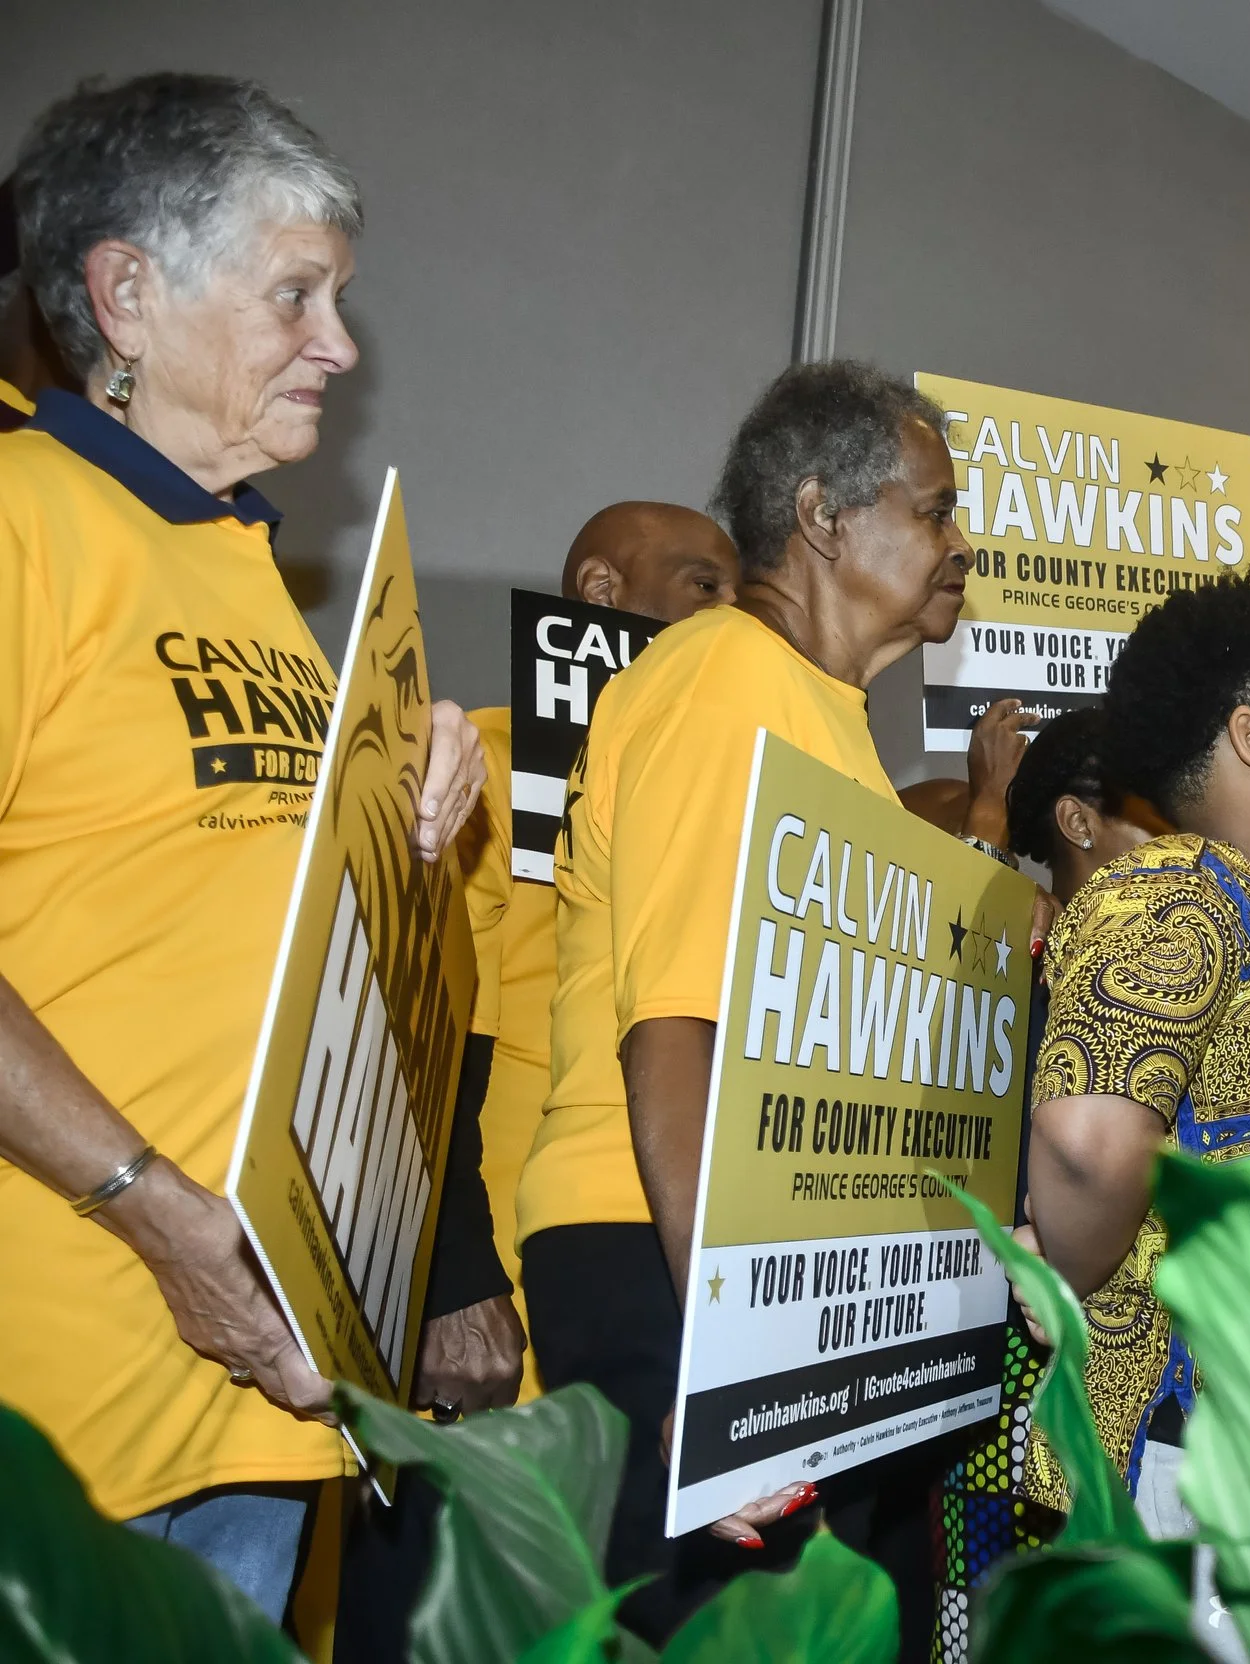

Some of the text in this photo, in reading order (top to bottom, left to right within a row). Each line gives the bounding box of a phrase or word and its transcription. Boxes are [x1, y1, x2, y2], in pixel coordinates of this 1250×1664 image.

[944, 410, 1120, 484] CALVIN
[951, 466, 1244, 566] HAWKINS
[966, 548, 1007, 580] OR
[1016, 552, 1107, 589] COUNTY
[1003, 588, 1060, 608] PRINCE
[1065, 594, 1140, 615] GEORGE'S
[155, 631, 330, 696] CALVIN
[536, 615, 654, 670] CAL
[971, 627, 1026, 656] YOUR
[1034, 631, 1098, 661] VOICE.
[1046, 662, 1086, 689] OUR
[253, 749, 323, 782] FOR CO
[767, 812, 934, 961] CALVIN
[743, 917, 1017, 1099] HAWKINS
[289, 850, 433, 1390] HAWK
[756, 1092, 993, 1160] FOR COUNTY EXECUTIVE
[792, 1172, 848, 1202] PRINCE
[851, 1172, 918, 1200] GEORGE'S
[748, 1238, 984, 1309] YOUR VOICE. YOUR LEADER.
[817, 1291, 928, 1354] OUR FUTURE.
[729, 1384, 850, 1443] calvinhawkins.org
[864, 1352, 977, 1402] IG:vote4calvinhawkins
